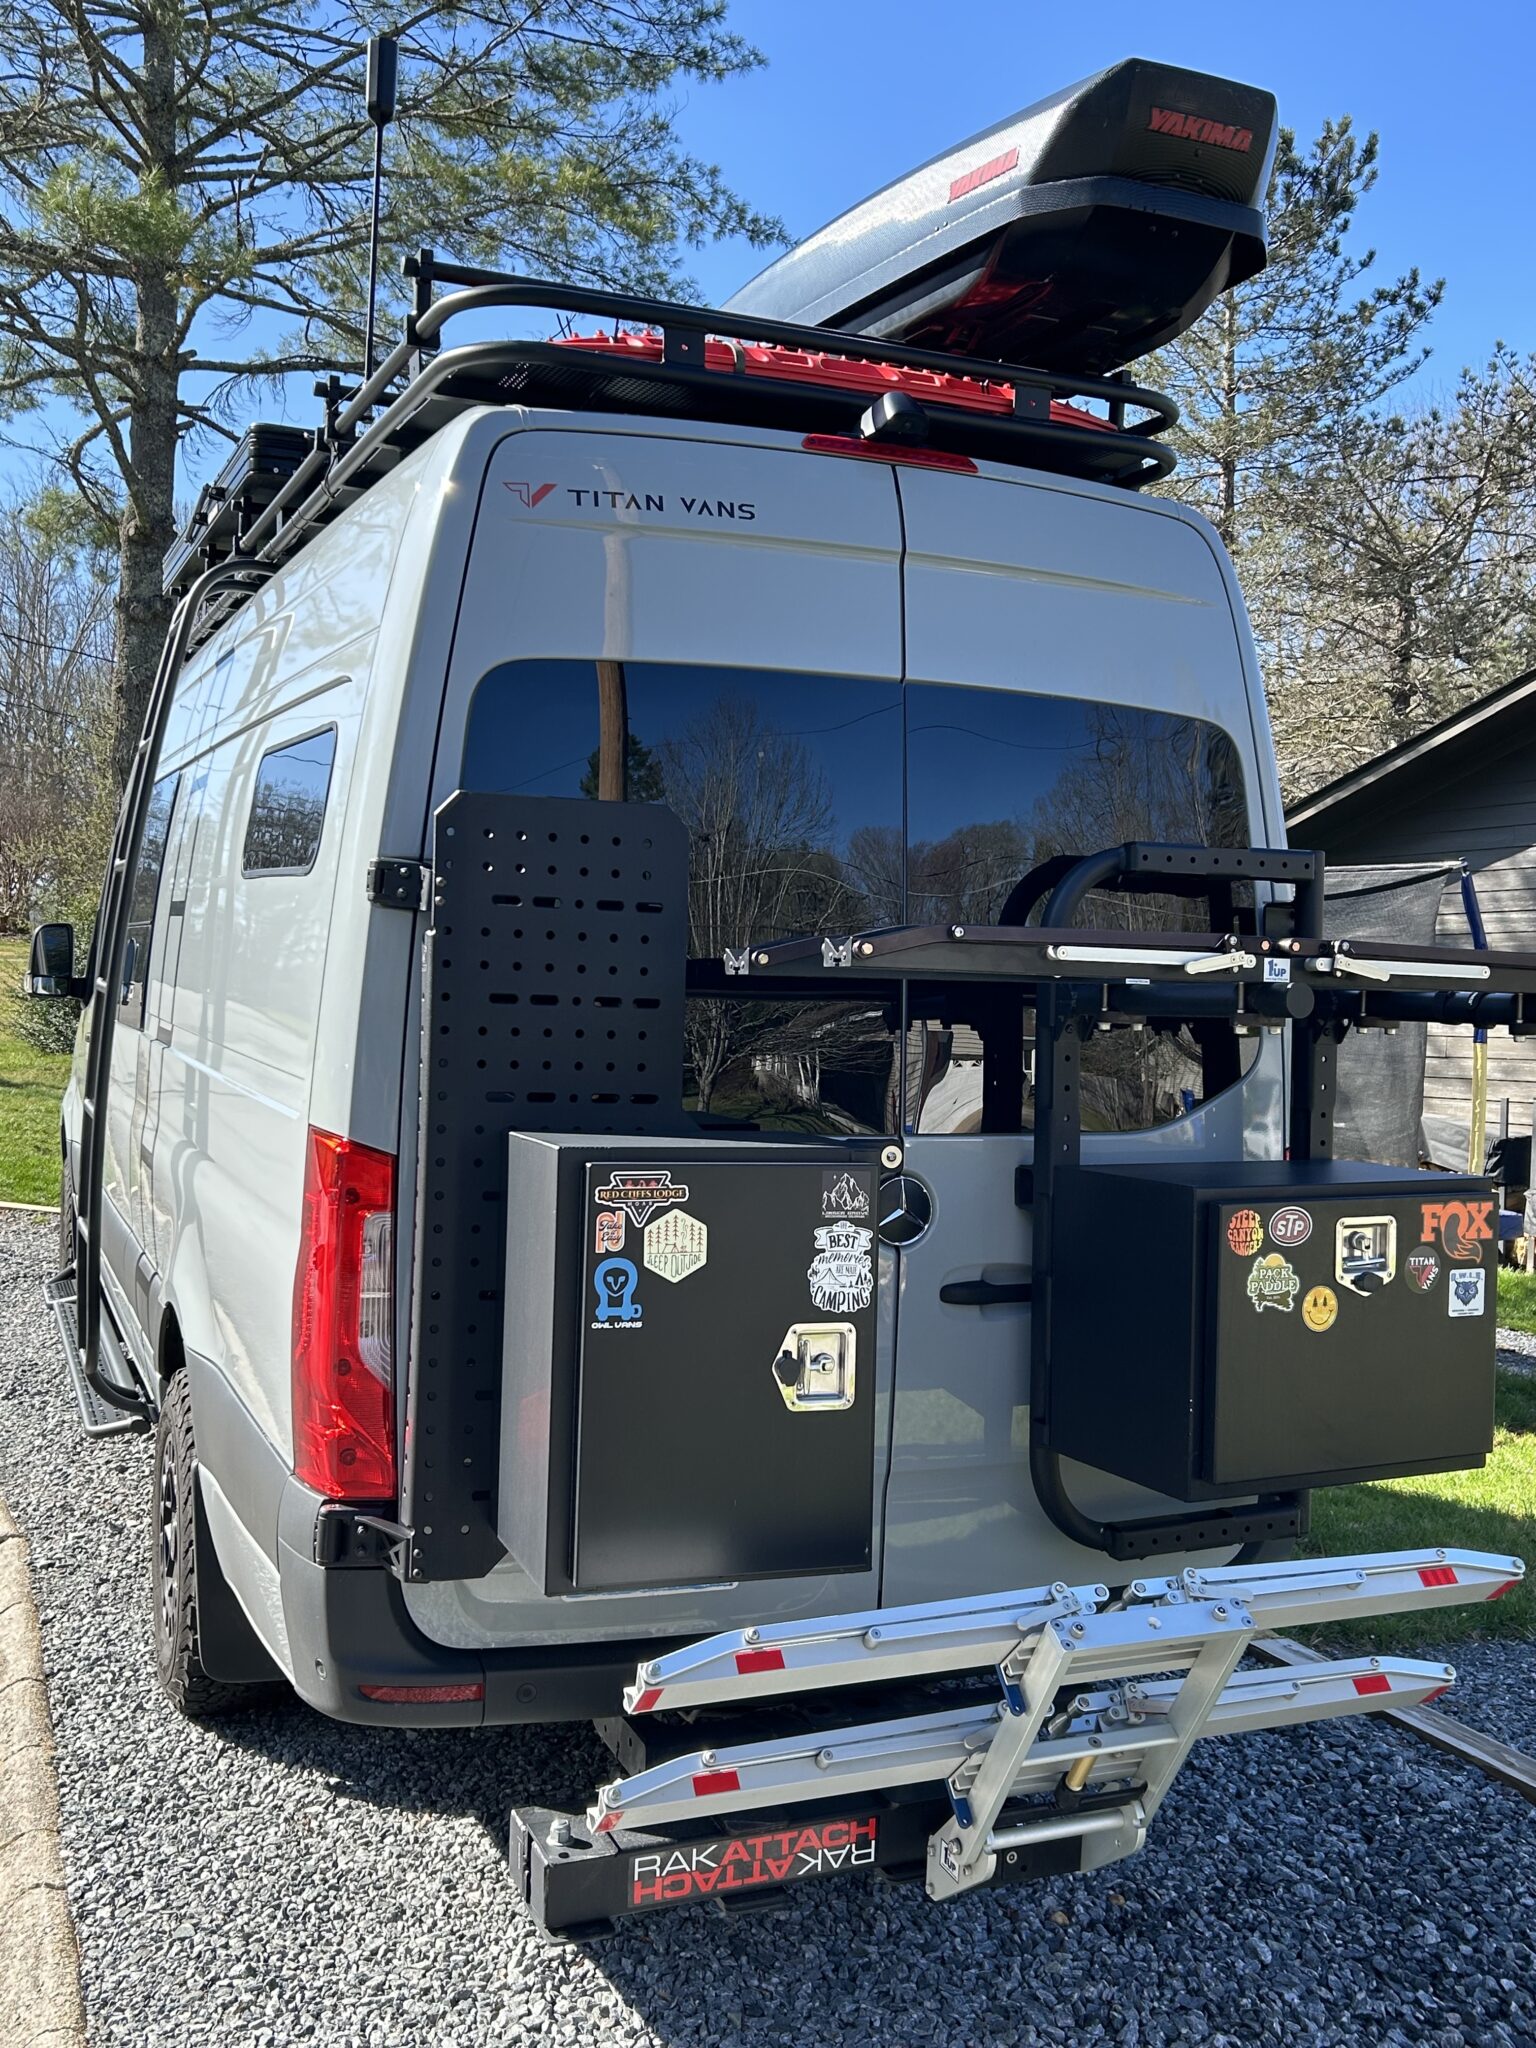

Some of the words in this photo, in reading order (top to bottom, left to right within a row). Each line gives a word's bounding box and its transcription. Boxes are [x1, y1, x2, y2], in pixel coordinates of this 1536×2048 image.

[1149, 106, 1253, 153] YAKIMA
[947, 145, 1020, 204] YAKIMA
[567, 488, 664, 512] TITAN
[680, 496, 756, 521] VANS
[600, 1190, 620, 1199] RED
[621, 1190, 652, 1199] CLIFFS
[653, 1189, 685, 1198] LODGE
[598, 1220, 623, 1232] Take
[1229, 1209, 1261, 1229] STEEP
[1276, 1214, 1305, 1237] STP
[601, 1231, 622, 1244] Easy
[1227, 1227, 1264, 1241] CANYON
[1420, 1200, 1494, 1263] FOX
[828, 1233, 859, 1249] BEST
[1229, 1239, 1263, 1256] RANGERS
[647, 1254, 669, 1274] SLEEP
[671, 1253, 702, 1279] OUTSIDE
[818, 1251, 870, 1268] memories
[1409, 1256, 1436, 1266] TITAN
[1259, 1268, 1290, 1279] PACK
[1421, 1265, 1439, 1291] VANS
[1251, 1280, 1296, 1292] PADDLE
[813, 1285, 869, 1312] CAMPING
[591, 1321, 614, 1330] OWL
[614, 1321, 643, 1329] VANS
[633, 1817, 877, 1882] RAKATTACH
